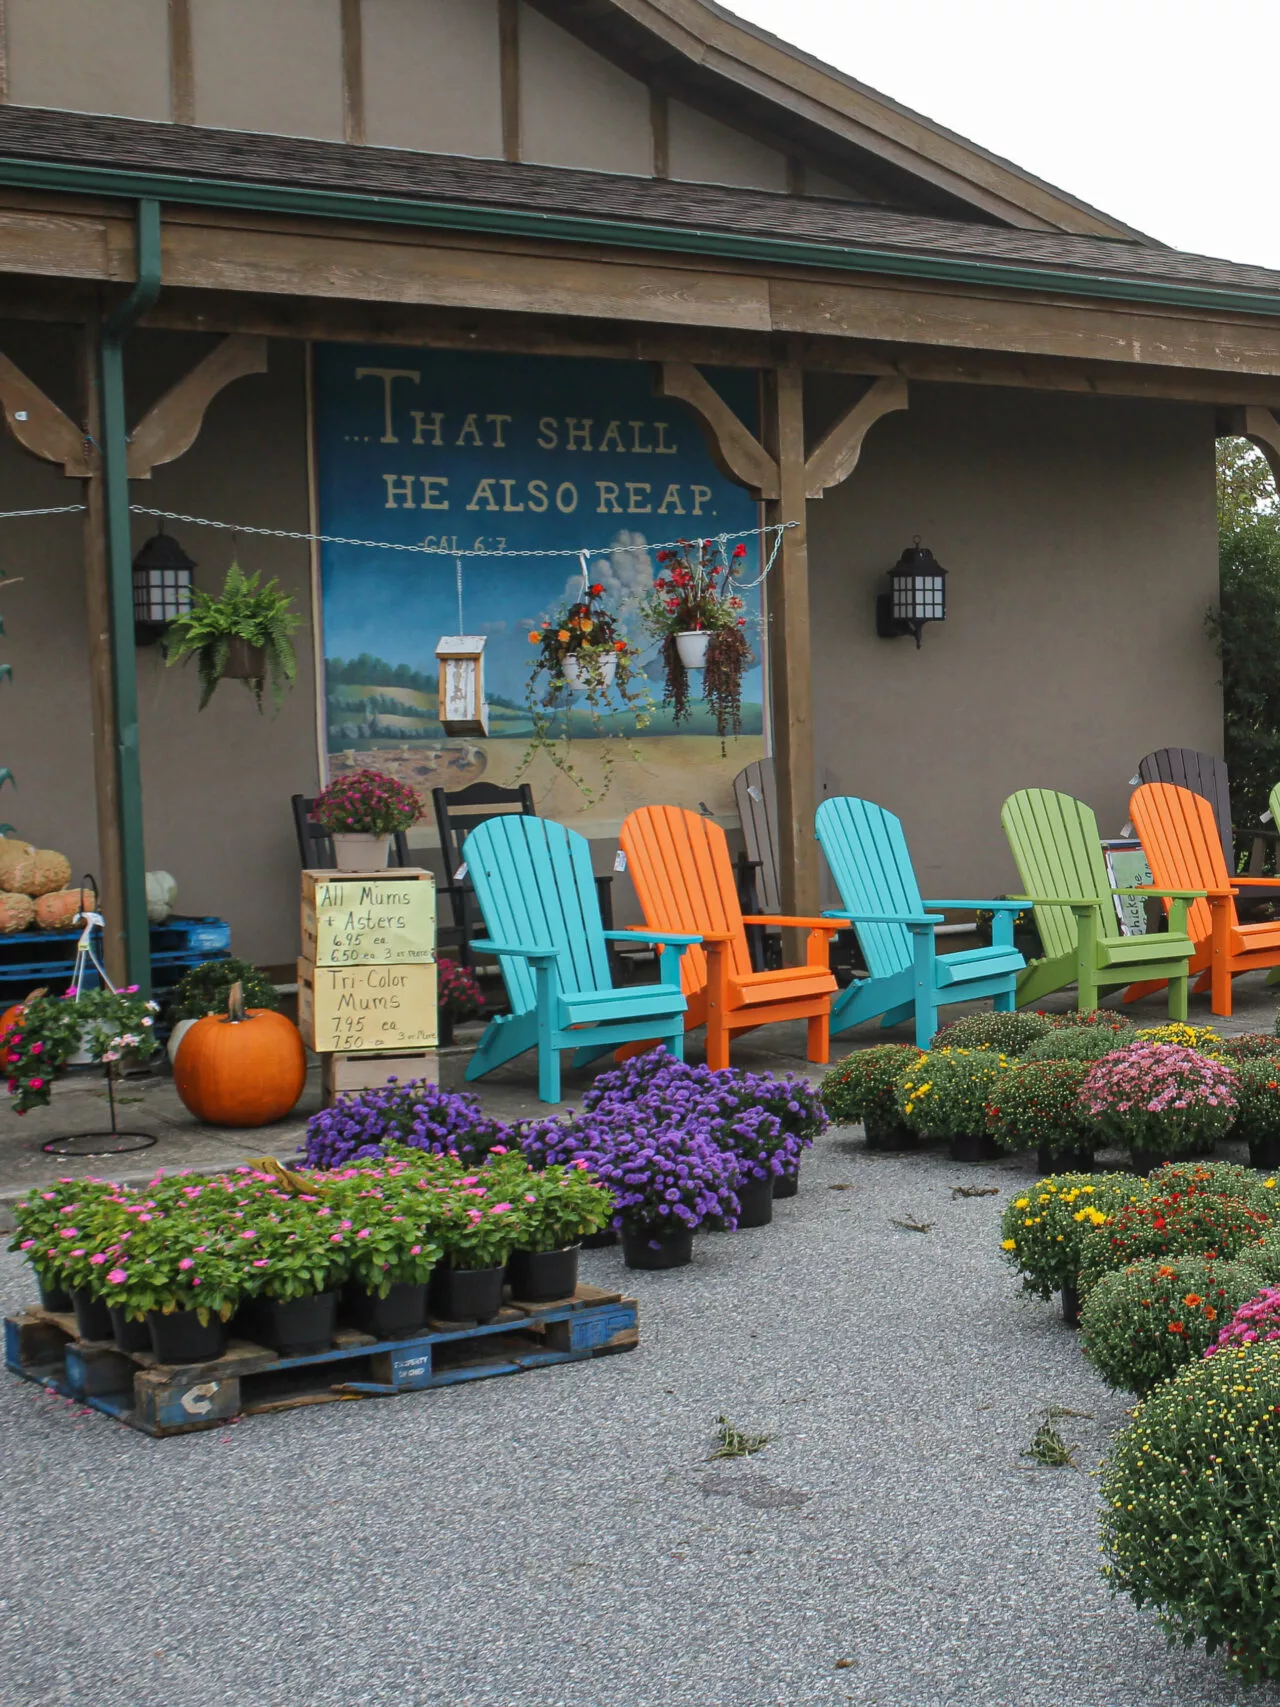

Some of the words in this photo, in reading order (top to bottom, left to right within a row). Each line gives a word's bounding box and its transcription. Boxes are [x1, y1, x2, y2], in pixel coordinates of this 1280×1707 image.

[536, 416, 679, 455] SHALL
[382, 474, 449, 511] HE
[465, 478, 579, 514] ALSO
[595, 481, 718, 516] REAP.
[321, 885, 344, 907] All
[360, 886, 411, 906] Mums
[344, 910, 406, 930] Asters
[1126, 885, 1142, 936] Chicke
[333, 933, 364, 947] 6.95
[384, 948, 393, 960] 3
[327, 968, 408, 990] Tri-Color
[337, 993, 401, 1011] Mums
[331, 1016, 366, 1032] 7.95
[332, 1035, 364, 1050] 7.50
[398, 1031, 405, 1041] 3
